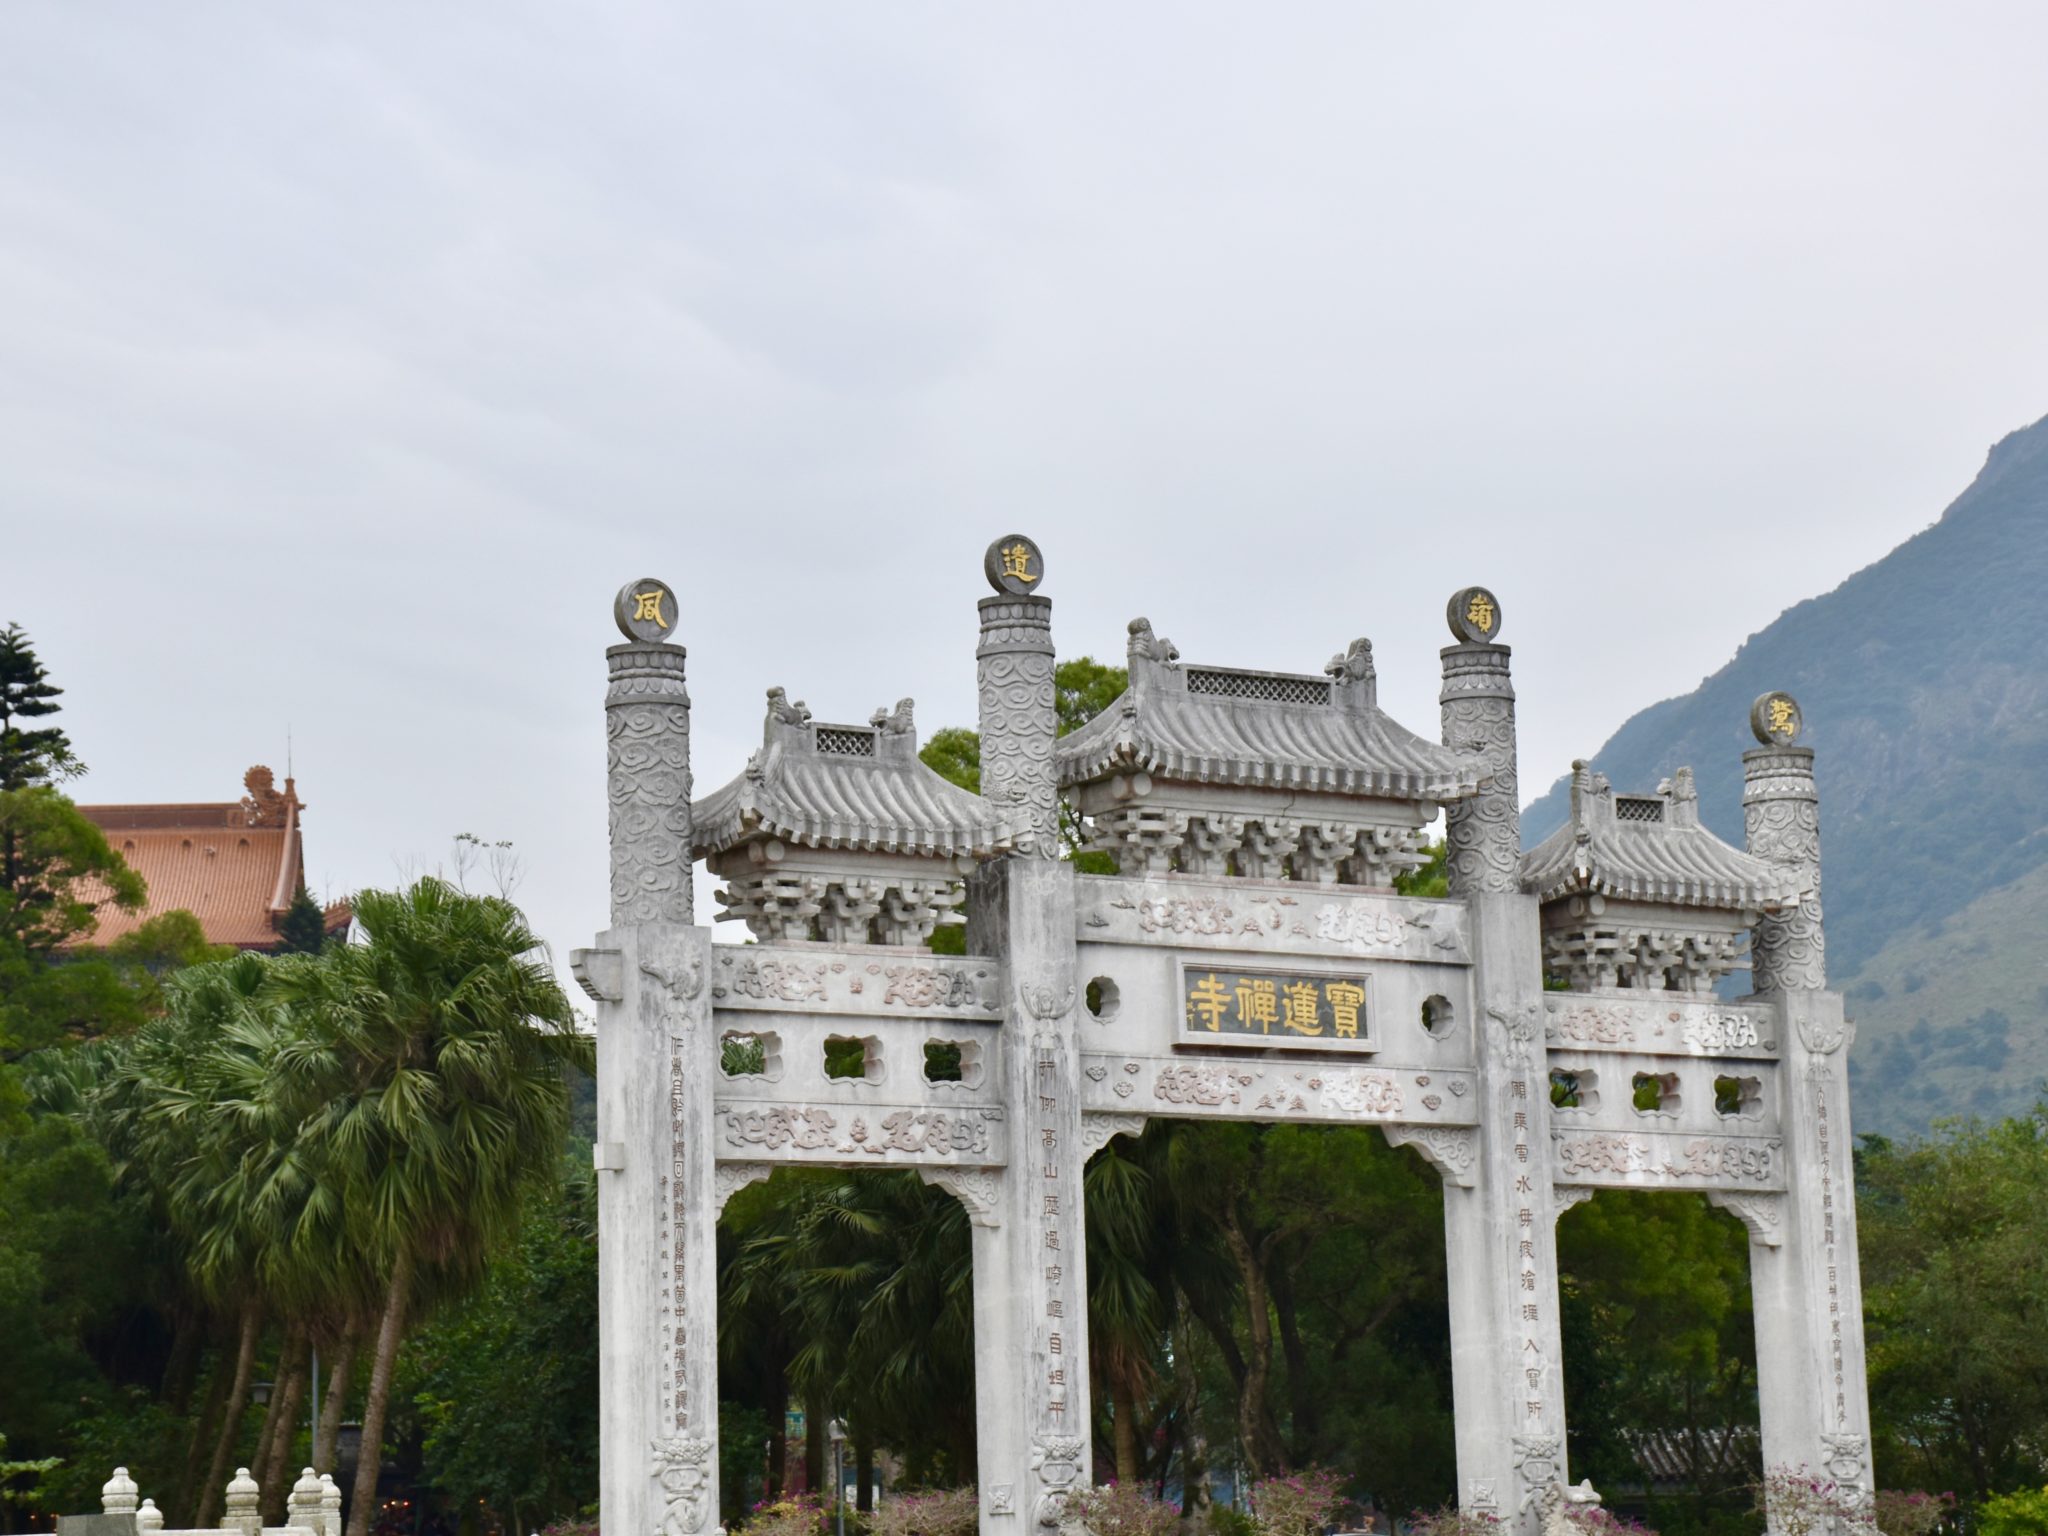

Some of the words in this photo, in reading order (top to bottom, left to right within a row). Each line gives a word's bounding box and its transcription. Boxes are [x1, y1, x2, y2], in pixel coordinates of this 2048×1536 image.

[1002, 543, 1038, 582] 遺
[1190, 973, 1365, 1039] 寶蓮禪寺
